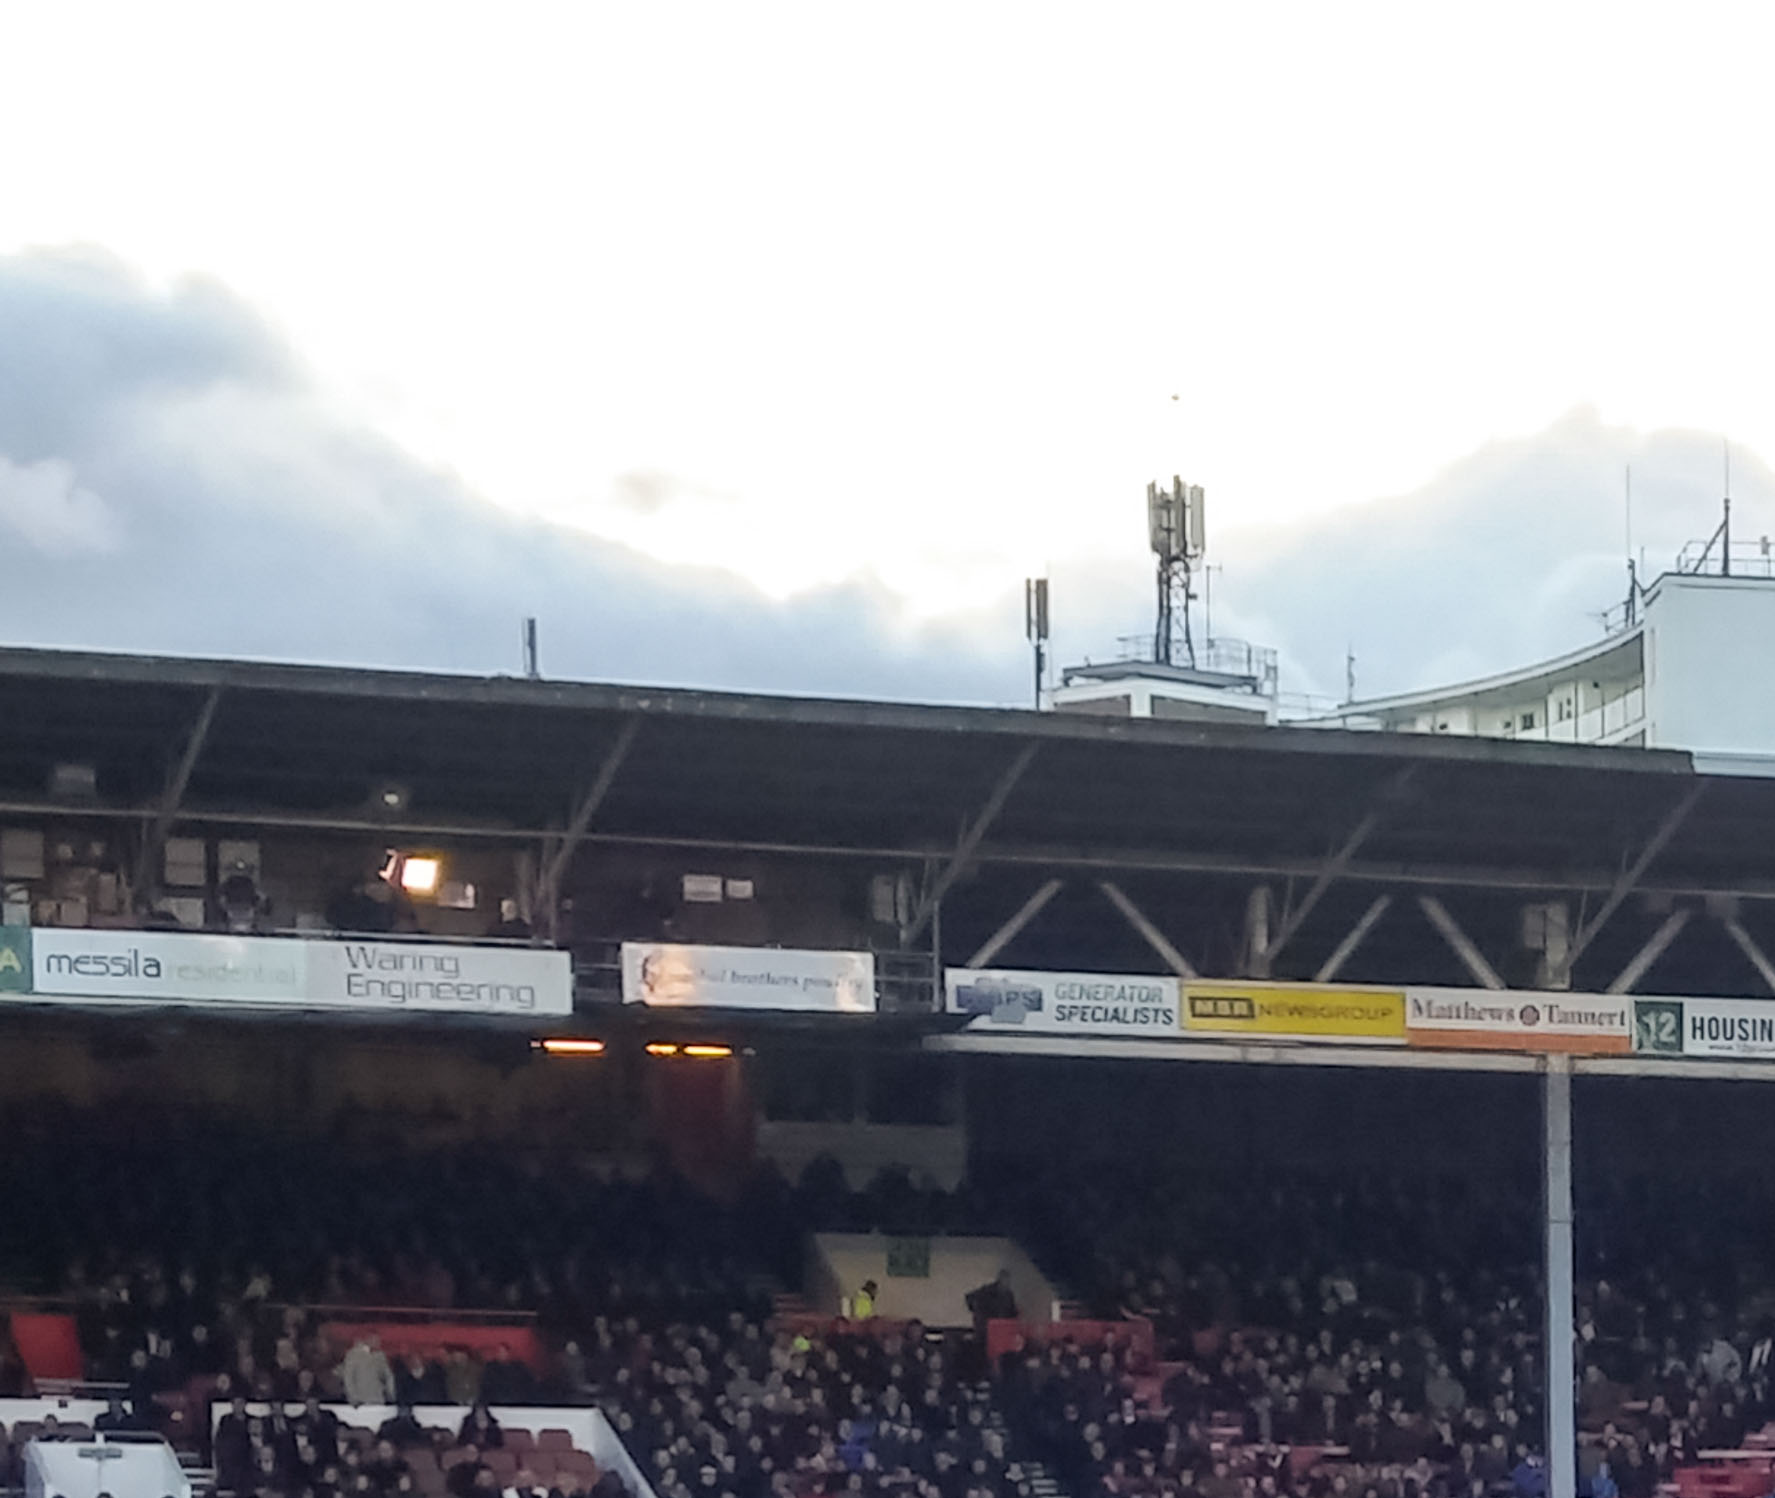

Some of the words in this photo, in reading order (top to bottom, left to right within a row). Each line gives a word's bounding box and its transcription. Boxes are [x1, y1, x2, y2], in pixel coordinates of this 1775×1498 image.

[47, 949, 161, 978] messila
[345, 946, 460, 979] Waring
[347, 973, 535, 1009] Engineering
[1055, 983, 1164, 1003] GENERATOR
[1055, 1004, 1174, 1025] SPECIALISTS
[1412, 998, 1515, 1022] Matthews
